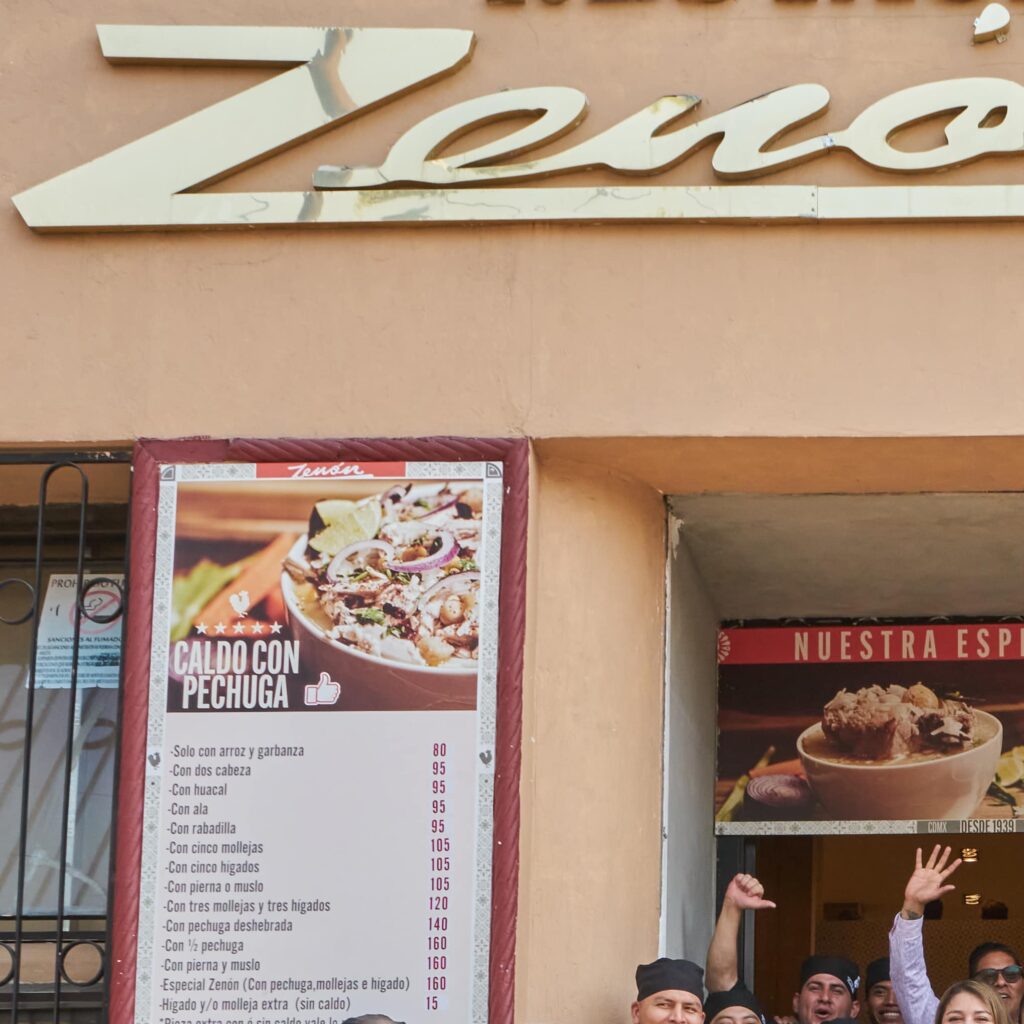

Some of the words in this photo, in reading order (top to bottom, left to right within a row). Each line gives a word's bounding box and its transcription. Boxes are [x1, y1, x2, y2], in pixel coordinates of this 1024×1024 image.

[287, 462, 374, 480] Zenón
[794, 629, 937, 660] NUESTRA
[174, 640, 247, 675] CALDO
[252, 639, 300, 674] CON
[182, 674, 289, 709] PECHUGA
[198, 746, 216, 757] con
[219, 746, 246, 757] arroz
[248, 746, 254, 760] y
[257, 744, 305, 760] garbanza
[433, 743, 447, 757] 80
[194, 764, 212, 777] dos
[215, 763, 251, 776] cabeza
[432, 761, 446, 775] 95
[194, 783, 228, 796] huacal
[432, 780, 446, 794] 95
[193, 802, 208, 815] ala
[432, 799, 446, 814] 95
[192, 821, 236, 834] rabadilla
[431, 819, 445, 833] 95
[961, 820, 990, 833] DESDE
[993, 819, 1015, 833] 1939
[191, 841, 218, 854] cinco
[221, 840, 264, 856] mollejas
[431, 838, 450, 852] 105
[190, 860, 217, 873] cinco
[431, 857, 450, 871] 105
[189, 880, 221, 895] pierna
[224, 882, 231, 893] o
[234, 880, 264, 893] muslo
[431, 877, 450, 891] 105
[189, 900, 210, 912] tres
[213, 899, 255, 915] mollejas
[258, 901, 264, 915] y
[267, 900, 288, 912] tres
[429, 896, 448, 910] 120
[188, 919, 230, 935] pechuga
[233, 918, 293, 932] deshebrada
[428, 917, 448, 931] 140
[201, 939, 244, 955] pechuga
[428, 936, 447, 950] 160
[186, 958, 218, 974] pierna
[221, 960, 227, 974] y
[230, 958, 261, 971] muslo
[428, 956, 446, 970] 160
[242, 977, 267, 992] (Con
[361, 980, 368, 990] e
[427, 976, 446, 991] 160
[200, 998, 218, 1013] y/o
[221, 997, 258, 1013] molleja
[261, 998, 289, 1010] extra
[295, 996, 315, 1012] (sin
[318, 996, 351, 1012] caldo)
[426, 996, 438, 1010] 15
